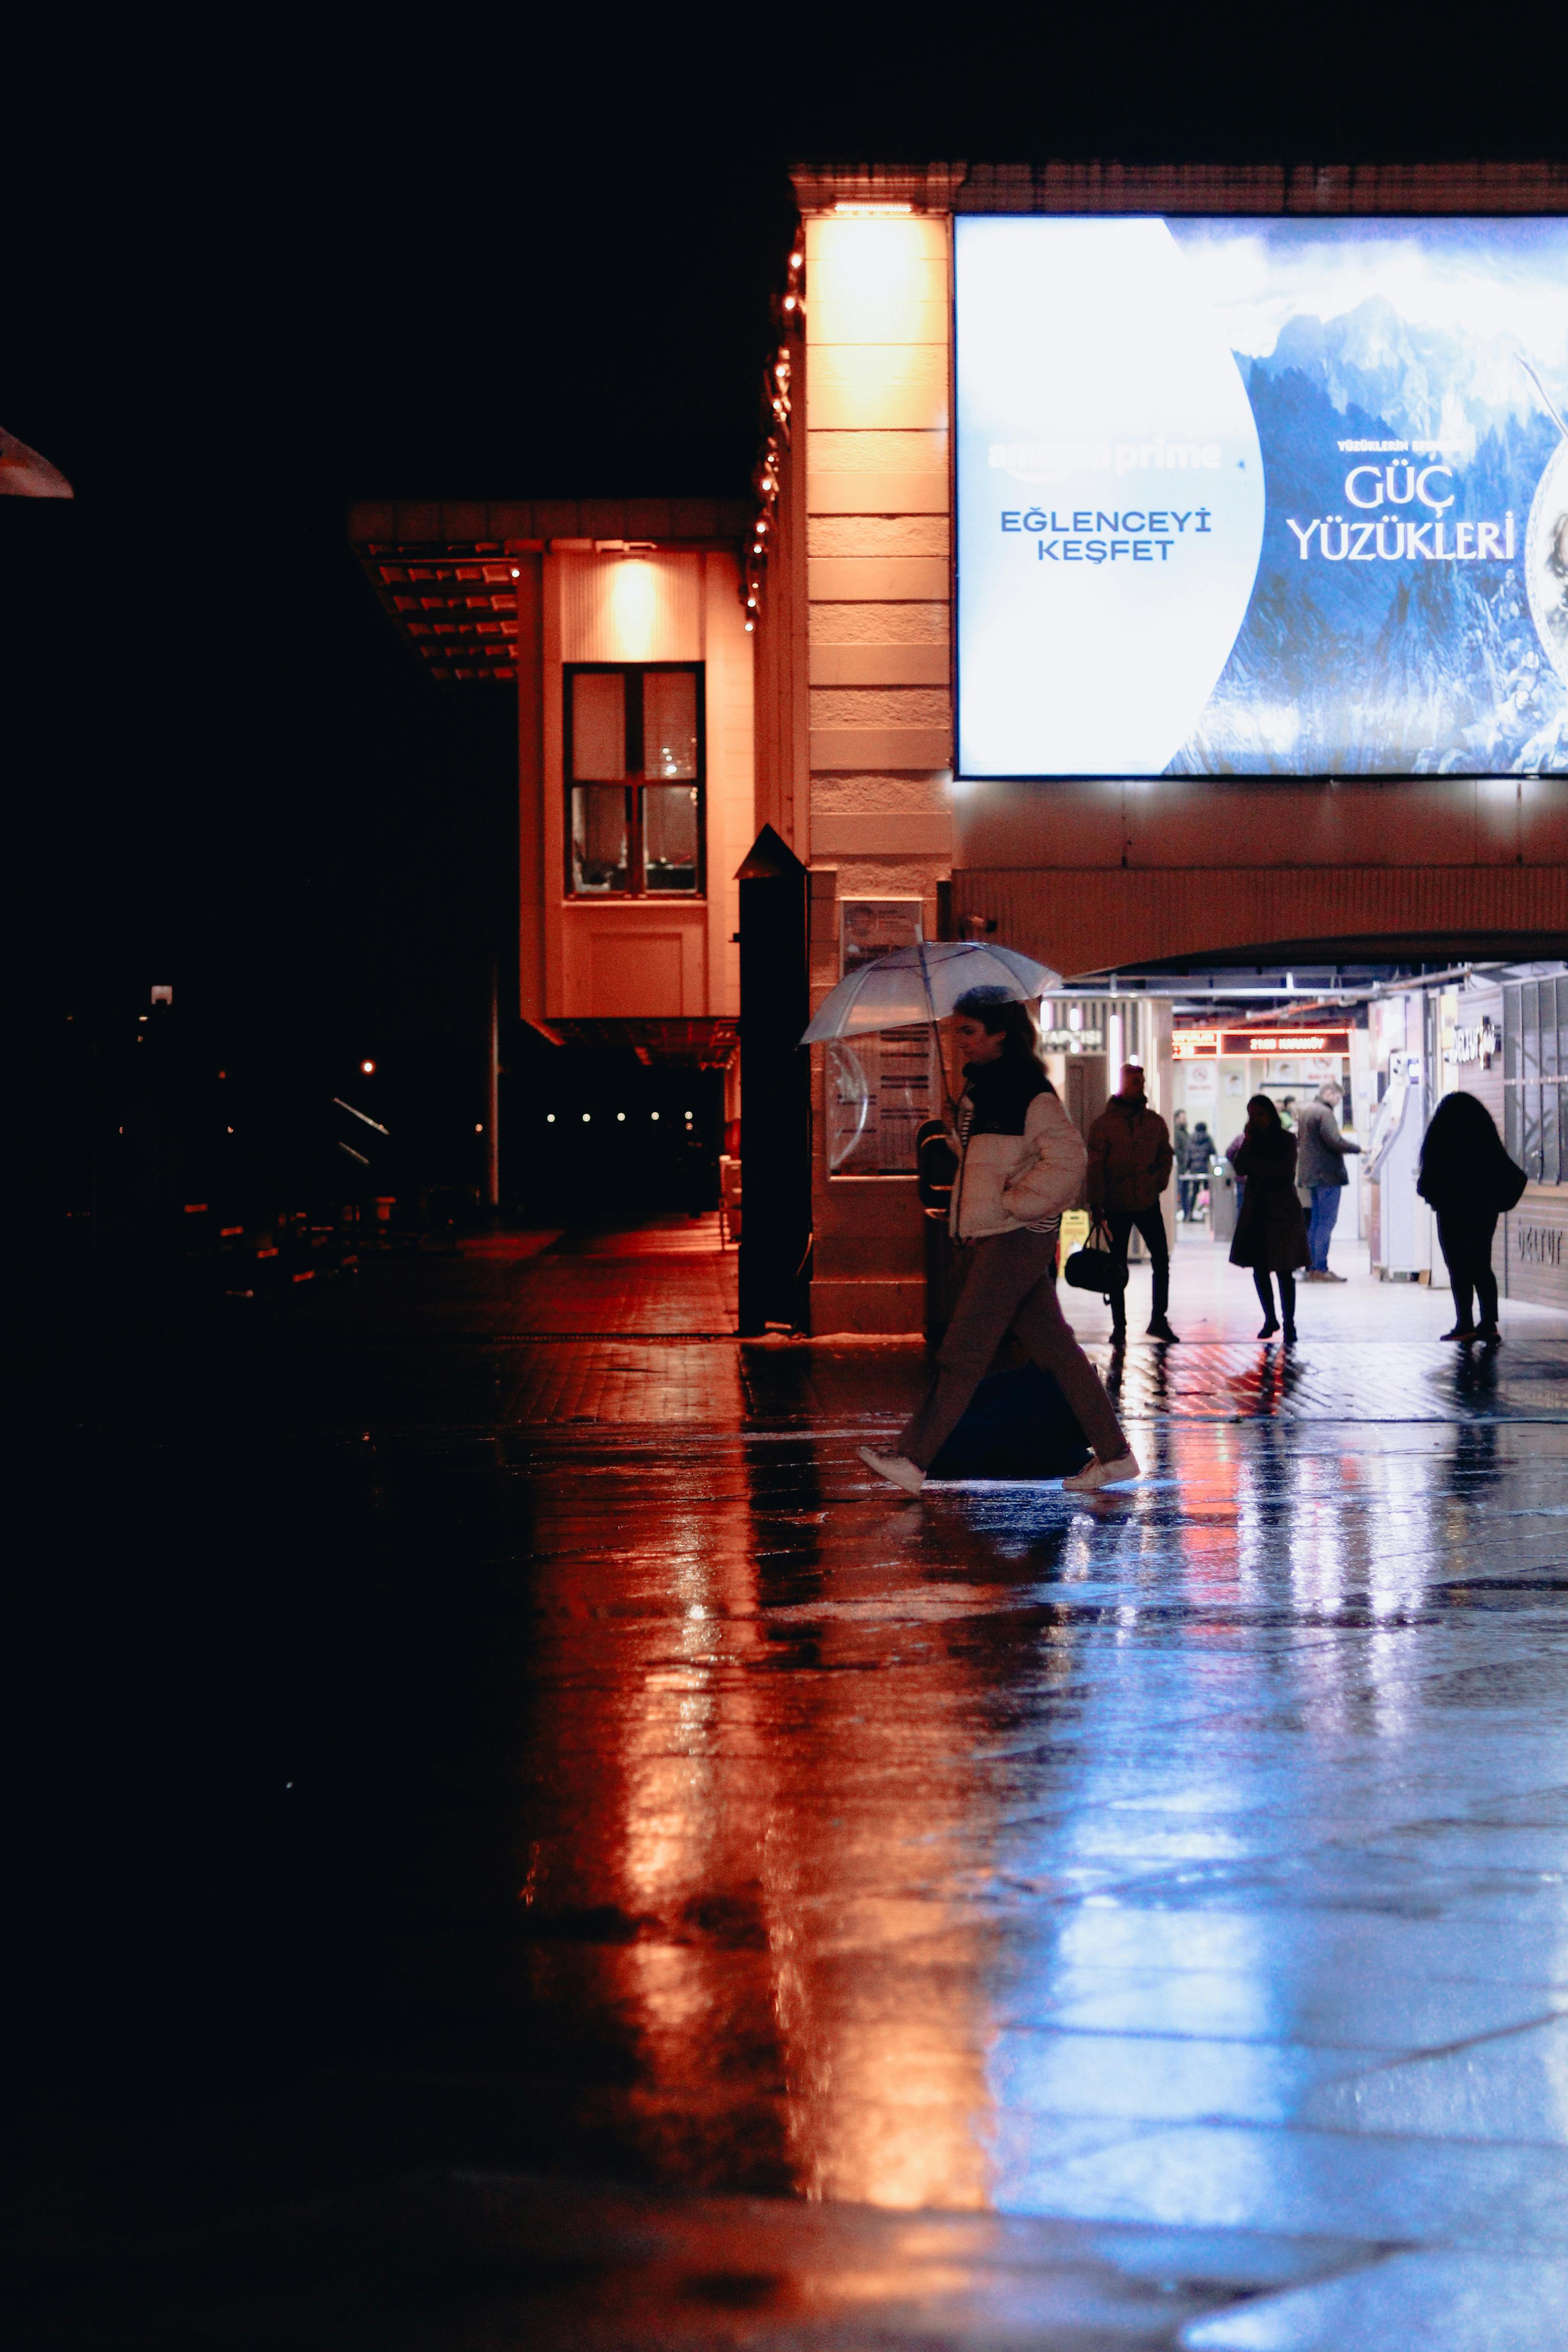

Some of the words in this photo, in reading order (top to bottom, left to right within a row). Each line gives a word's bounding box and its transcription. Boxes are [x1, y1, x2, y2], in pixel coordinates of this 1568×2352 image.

[1116, 437, 1222, 476] prime
[1345, 459, 1455, 518] GÜÇ
[1001, 507, 1211, 532] EĞLENCEYİ
[1286, 511, 1515, 561] YÜZÜKLERİ
[1038, 540, 1174, 564] KEŞFET
